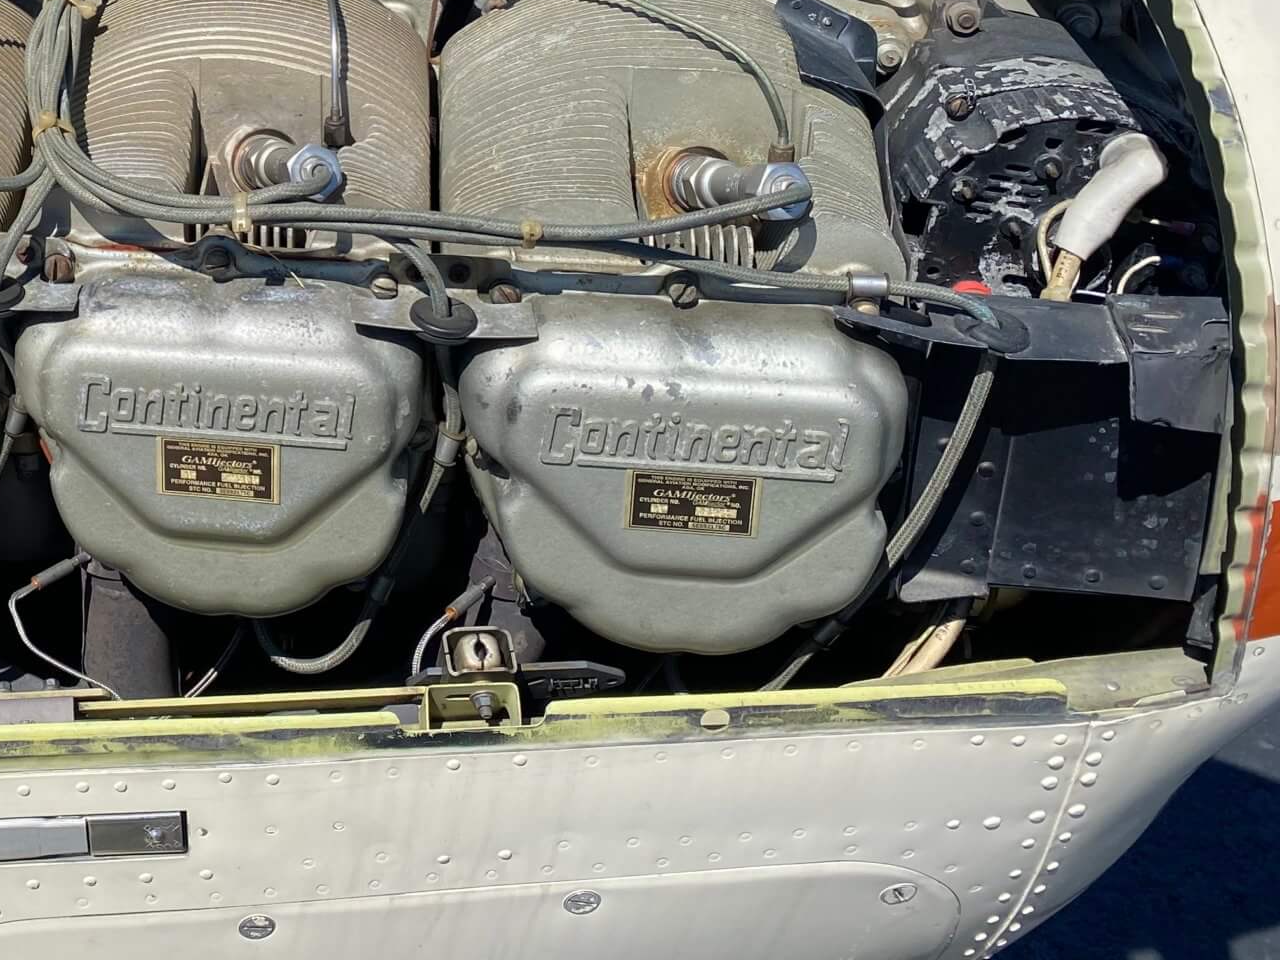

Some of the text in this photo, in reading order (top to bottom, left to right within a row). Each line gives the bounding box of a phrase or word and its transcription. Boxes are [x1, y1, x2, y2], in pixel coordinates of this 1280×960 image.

[79, 374, 356, 440] Continental
[540, 407, 850, 471] Continental
[639, 512, 689, 522] PERFORMANCE
